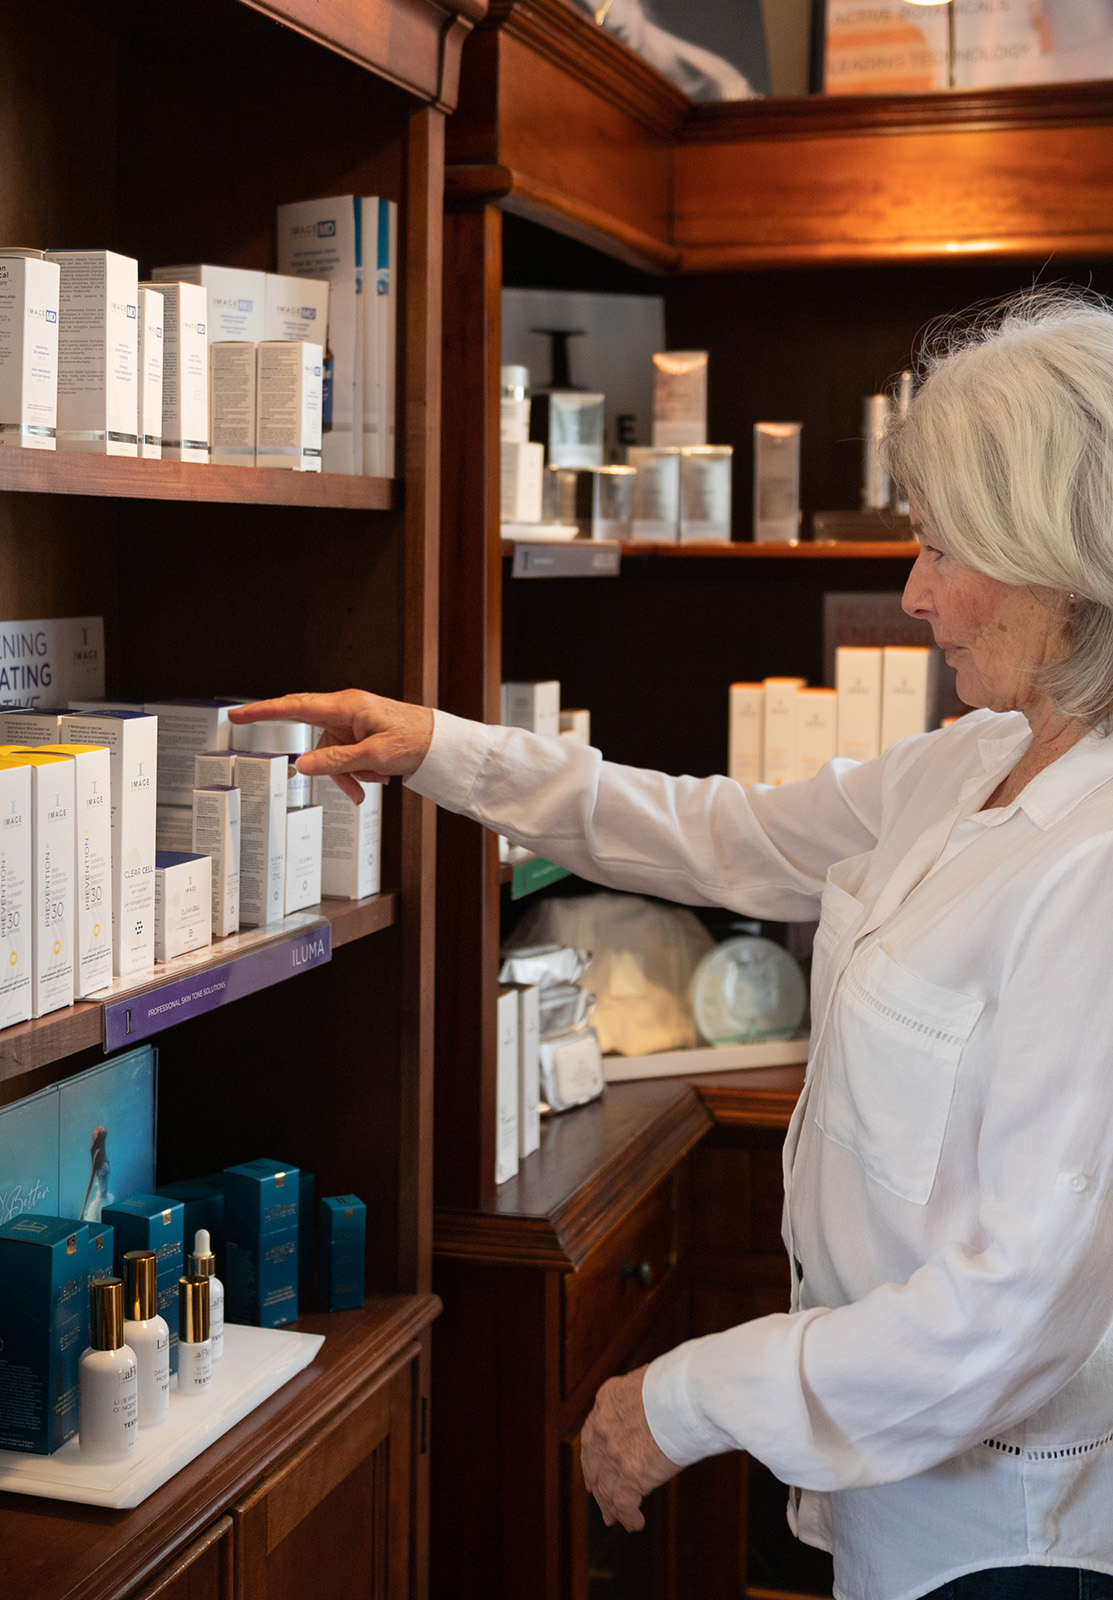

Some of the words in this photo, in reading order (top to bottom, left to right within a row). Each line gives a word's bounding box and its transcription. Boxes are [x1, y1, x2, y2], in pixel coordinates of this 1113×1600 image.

[0, 632, 47, 659] NING
[131, 778, 150, 788] IMAGE
[86, 796, 104, 806] IMAGE
[3, 815, 22, 826] IMAGE
[48, 809, 67, 819] IMAGE
[124, 868, 141, 879] CLEAR
[142, 865, 154, 875] CELL
[90, 885, 103, 903] 30
[51, 901, 64, 919] 30
[7, 911, 20, 929] 30
[292, 939, 325, 967] ILUMA
[148, 1000, 181, 1017] PROFESSIONAL
[181, 995, 192, 1005] SKIN
[192, 990, 203, 1001] TONE
[203, 981, 226, 996] SOLUTIONS
